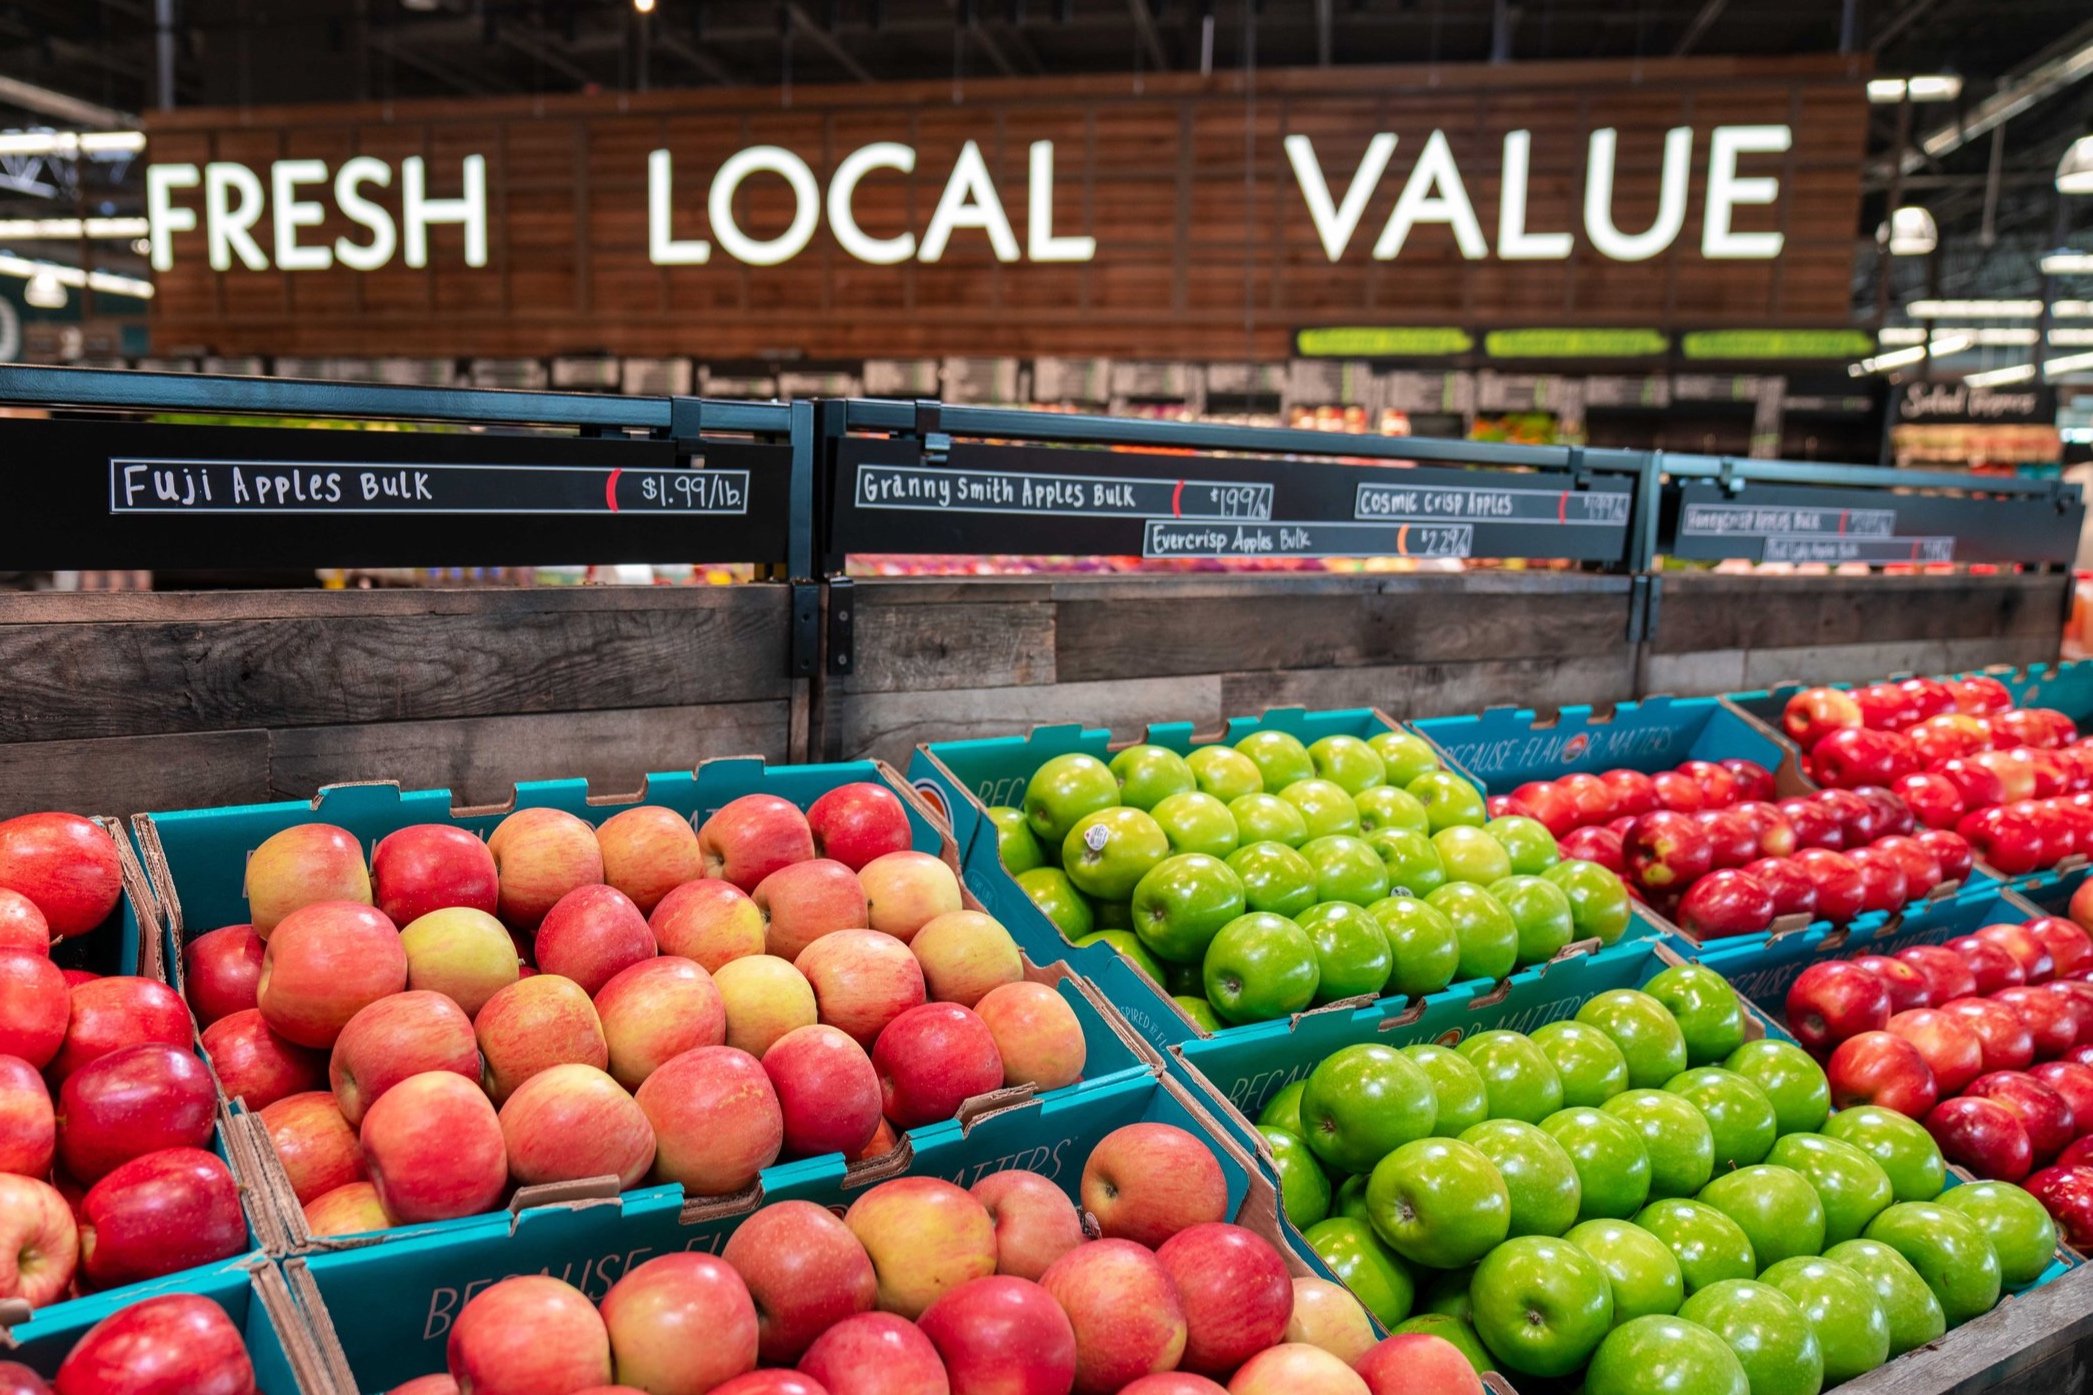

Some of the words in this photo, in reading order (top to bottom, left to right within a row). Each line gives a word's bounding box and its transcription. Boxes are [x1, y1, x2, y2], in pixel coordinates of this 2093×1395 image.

[147, 155, 489, 271] FRESH
[648, 139, 1096, 266] LOCAL
[1284, 124, 1793, 261] VALUE
[124, 465, 212, 506] Fuji
[233, 466, 341, 504] Apples
[864, 472, 950, 507] Granny
[957, 475, 1014, 504] Smith
[1022, 478, 1085, 508] Apples
[1152, 525, 1228, 554] Evercrisp
[1231, 526, 1273, 553] Apples
[1119, 1006, 1150, 1029] SPIRED
